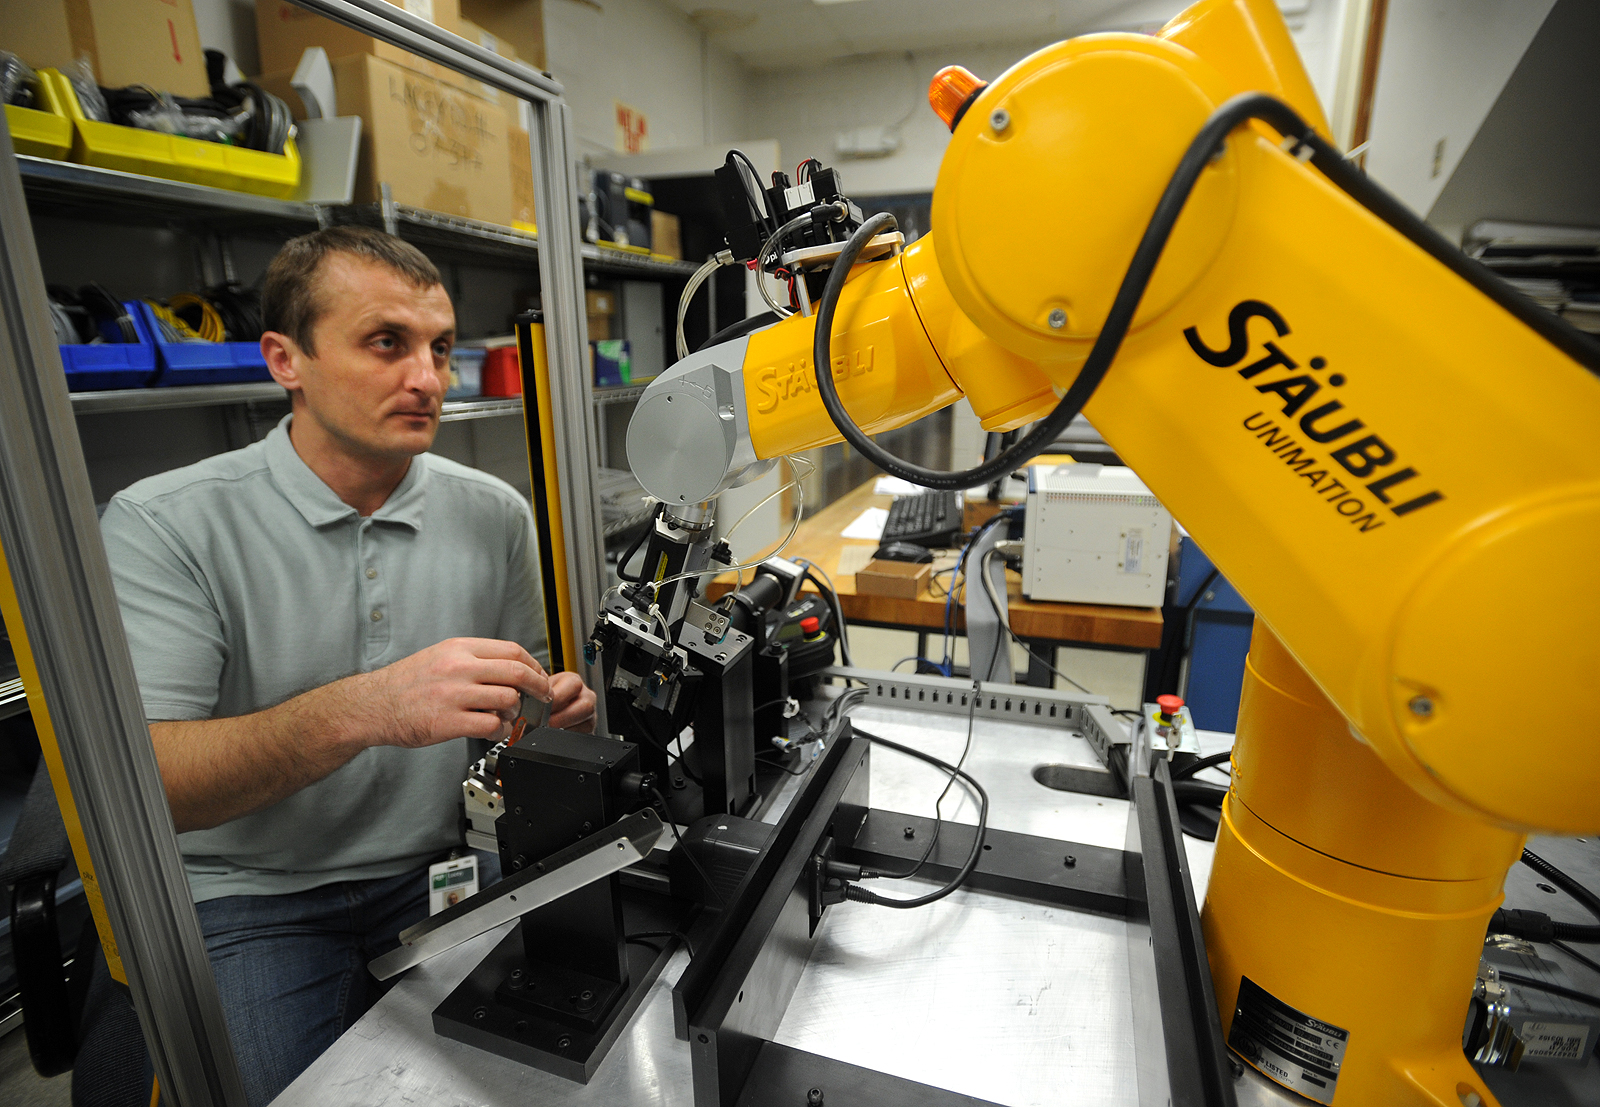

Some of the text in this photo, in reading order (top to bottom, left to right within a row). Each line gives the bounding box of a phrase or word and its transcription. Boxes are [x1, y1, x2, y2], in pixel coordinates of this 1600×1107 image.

[755, 345, 874, 414] STÄBLI
[1183, 299, 1444, 517] STÄUBLI
[1243, 411, 1386, 533] UNIMATION
[1305, 1019, 1343, 1038] STÄUBLI
[1265, 1060, 1289, 1078] LISTED
